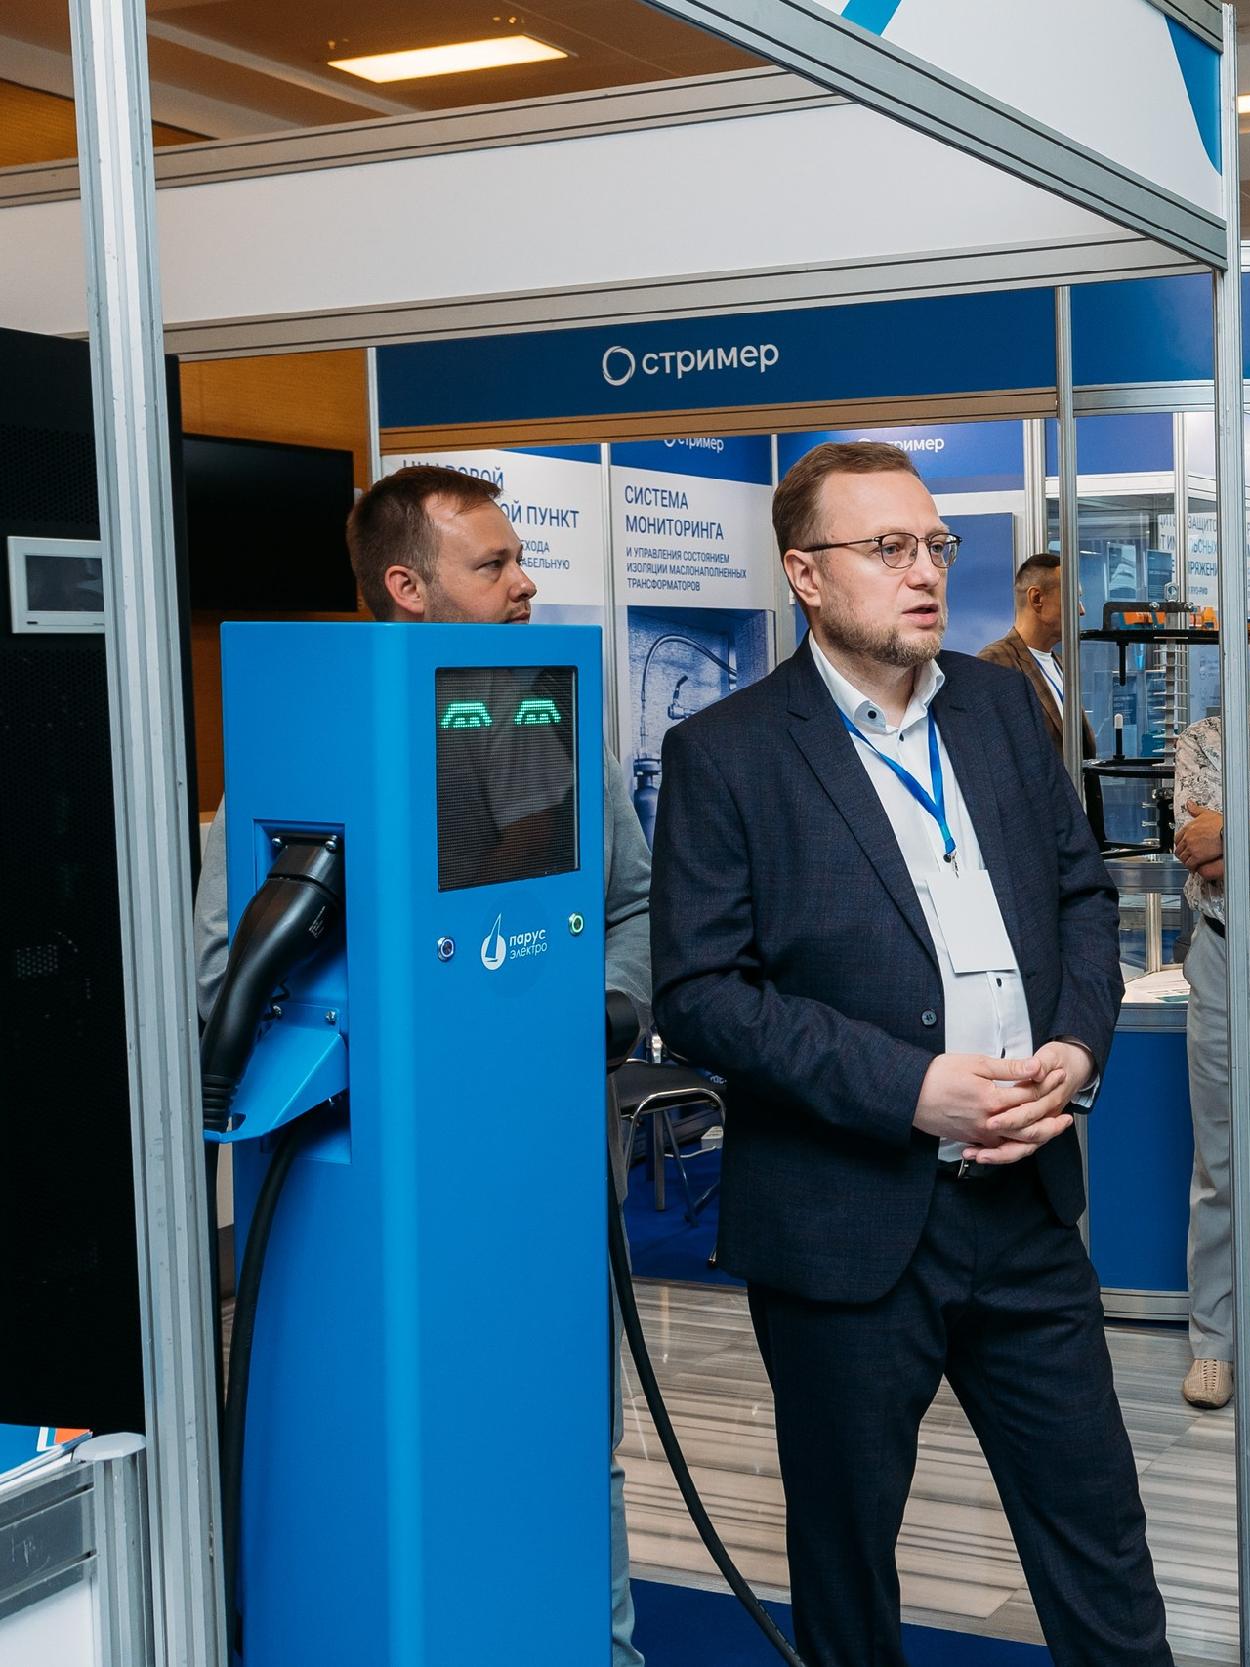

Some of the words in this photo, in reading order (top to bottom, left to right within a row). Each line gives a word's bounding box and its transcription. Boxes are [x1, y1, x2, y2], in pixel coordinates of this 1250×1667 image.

[641, 343, 780, 380] стример
[624, 484, 690, 510] СИСТЕМА
[526, 505, 580, 529] ПУНКТ
[625, 514, 725, 541] МОНИТОРИНГА
[626, 546, 633, 557] И
[634, 547, 683, 560] УПРАВЛЕНИЯ
[683, 551, 730, 564] СОСТОЯНИЕМ
[626, 562, 669, 576] ИЗОЛЯЦИИ
[669, 566, 747, 580] МАСЛОНАПОЛНЕННЫХ
[627, 577, 701, 592] ТРАНСФОРМАТОРОВ
[509, 929, 547, 947] парус
[509, 942, 548, 960] электро
